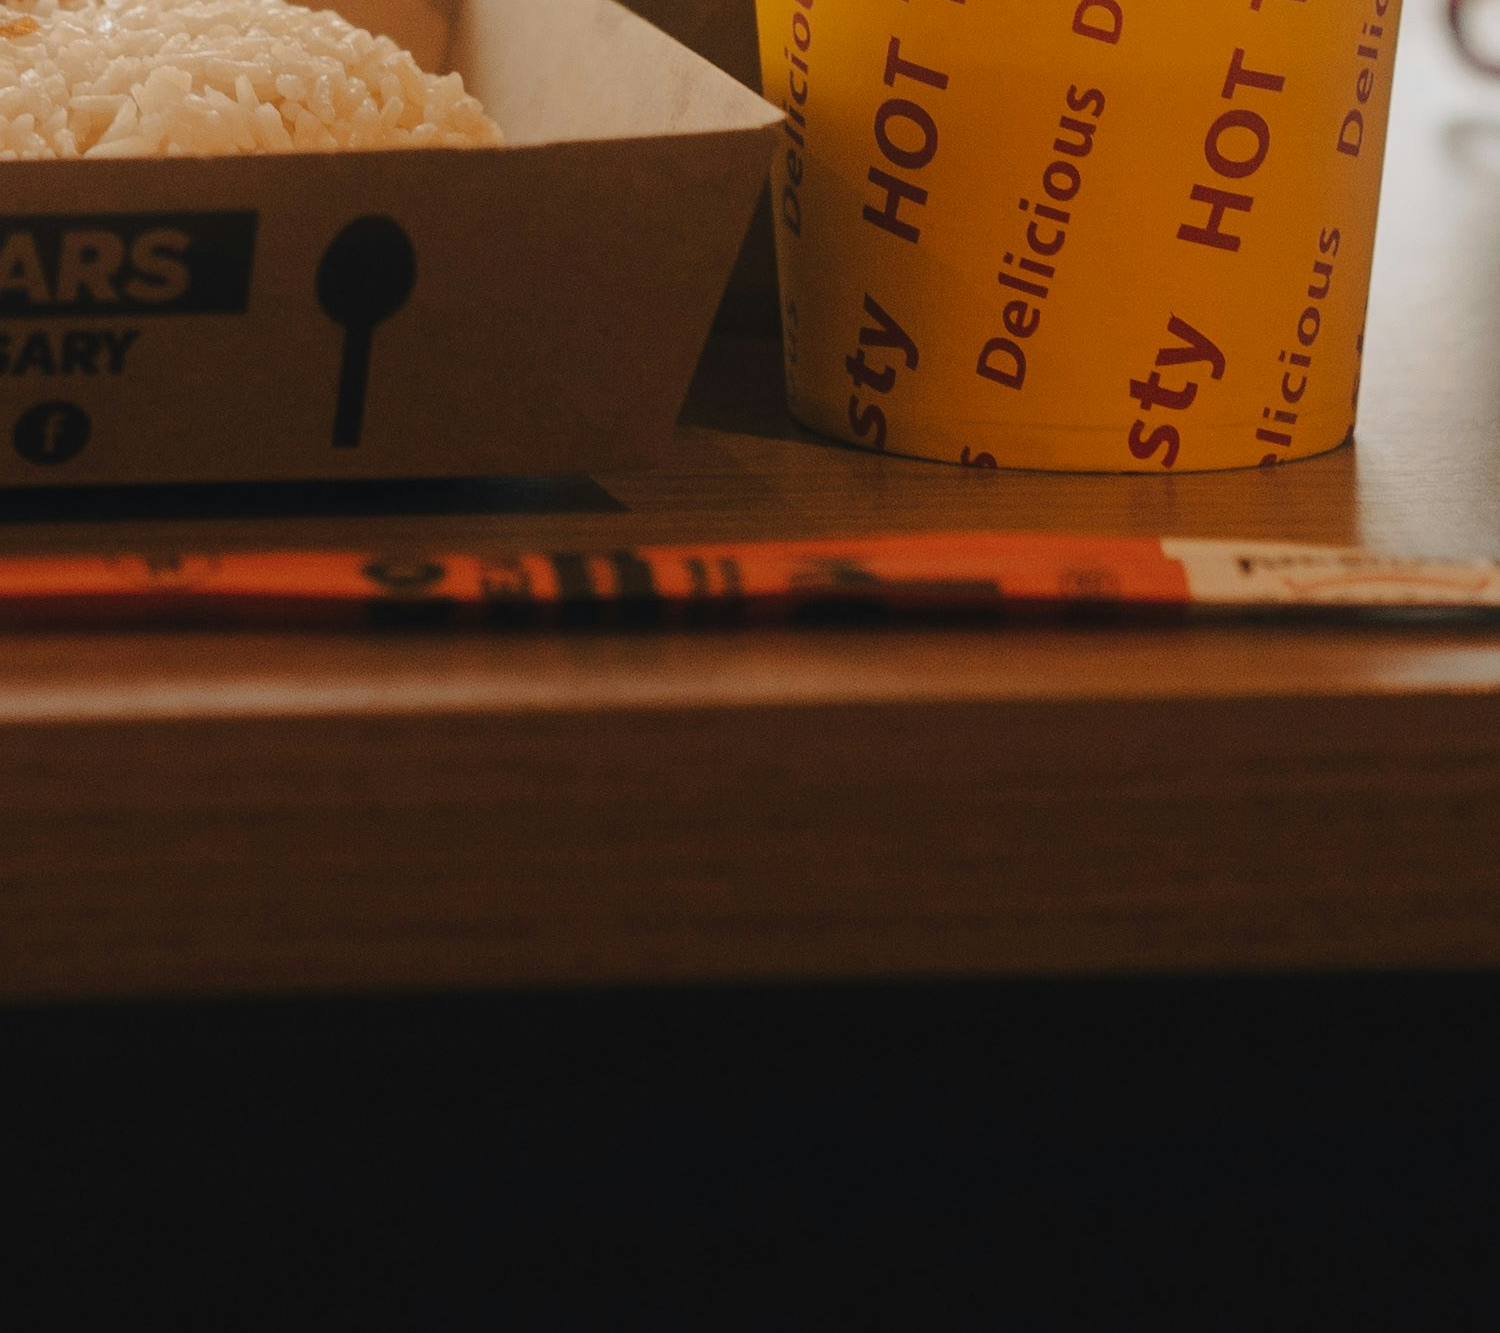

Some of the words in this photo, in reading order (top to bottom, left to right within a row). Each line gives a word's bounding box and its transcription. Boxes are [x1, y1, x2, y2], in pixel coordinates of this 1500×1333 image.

[862, 36, 951, 245] HOT
[975, 83, 1107, 391] Delicious
[1176, 48, 1287, 253] HOT
[1128, 312, 1226, 469] sty
